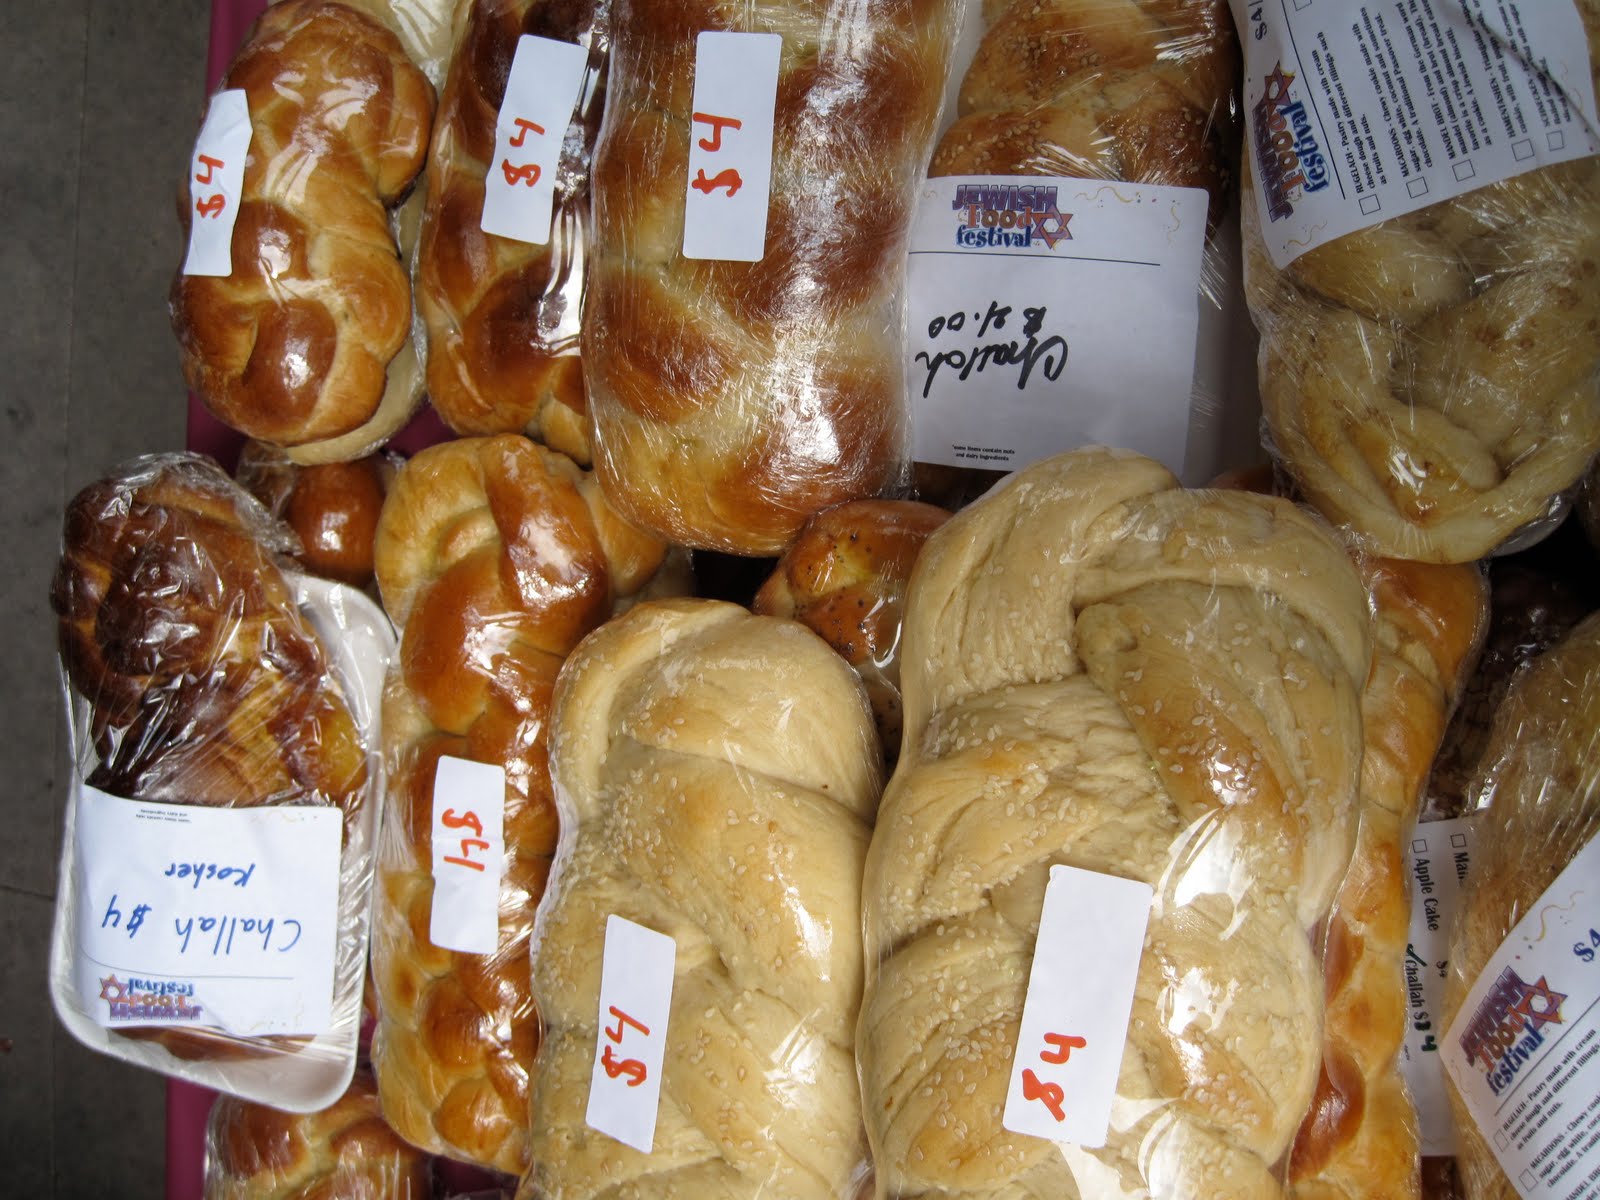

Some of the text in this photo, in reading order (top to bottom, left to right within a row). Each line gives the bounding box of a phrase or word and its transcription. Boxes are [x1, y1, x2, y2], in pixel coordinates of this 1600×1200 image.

[1396, 2, 1409, 23] word
[1352, 23, 1363, 41] with
[1361, 7, 1380, 51] sometimes
[1406, 25, 1421, 58] German
[1430, 22, 1444, 47] bread
[1312, 50, 1324, 75] cream
[1360, 44, 1372, 66] made
[1375, 53, 1387, 69] and
[1384, 39, 1401, 75] Passover
[1427, 51, 1438, 69] brot
[1439, 49, 1455, 77] almond
[1471, 28, 1493, 71] Triangular
[1418, 60, 1427, 73] the
[1433, 70, 1444, 84] and
[1458, 61, 1472, 87] Jewish
[1321, 77, 1331, 95] with
[1369, 68, 1382, 94] cookie
[1382, 71, 1398, 103] coconut
[1423, 75, 1435, 96] From
[1451, 79, 1463, 100] crisp
[1506, 84, 1516, 102] with
[1317, 32, 1375, 189] cheese dough and different fillings such
[1328, 97, 1340, 119] made
[1380, 97, 1391, 122] Chewy
[1397, 76, 1416, 118] traditional
[1440, 87, 1458, 123] (almond)
[1491, 78, 1515, 137] HAMENTASHEN
[1432, 103, 1444, 125] BROT
[1462, 109, 1469, 118] is
[1280, 100, 1330, 193] festival
[1337, 122, 1349, 146] Pastry
[1365, 135, 1376, 150] and
[1403, 129, 1412, 145] egg
[1440, 127, 1455, 159] MANDEL
[1452, 125, 1468, 154] mandel
[1465, 120, 1480, 150] favorite
[1485, 135, 1492, 145] as
[502, 118, 545, 187] $4
[692, 112, 742, 197] $4
[1252, 101, 1295, 223] JEWISH
[1373, 152, 1383, 174] fruits
[1390, 128, 1409, 177] MACAROONS
[195, 154, 226, 219] $4
[1346, 152, 1364, 193] RUGELACH
[1380, 175, 1387, 184] as
[952, 184, 1058, 212] JEWISH
[956, 225, 1031, 248] festival
[442, 808, 490, 872] $4
[1413, 858, 1440, 931] Apple Cake
[102, 894, 302, 955] Challah $4
[128, 978, 194, 997] festival
[1406, 959, 1425, 1008] Challah
[110, 1005, 204, 1020] JEWISH
[1459, 965, 1523, 1067] JEWISH
[601, 1006, 650, 1087] $4
[1486, 1019, 1545, 1096] festival
[1021, 1032, 1087, 1122] $4
[1527, 1082, 1546, 1101] Pastry
[1546, 1065, 1562, 1082] made
[1562, 1051, 1576, 1065] with
[1576, 1030, 1596, 1050] cream
[1525, 1104, 1542, 1123] dough
[1542, 1092, 1553, 1105] and
[1552, 1066, 1578, 1093] different
[1517, 1142, 1524, 1150] as
[1537, 1115, 1548, 1128] and
[1530, 1135, 1564, 1169] MACAROONS
[1567, 1112, 1587, 1131] Chewy
[1557, 1148, 1570, 1160] egg
